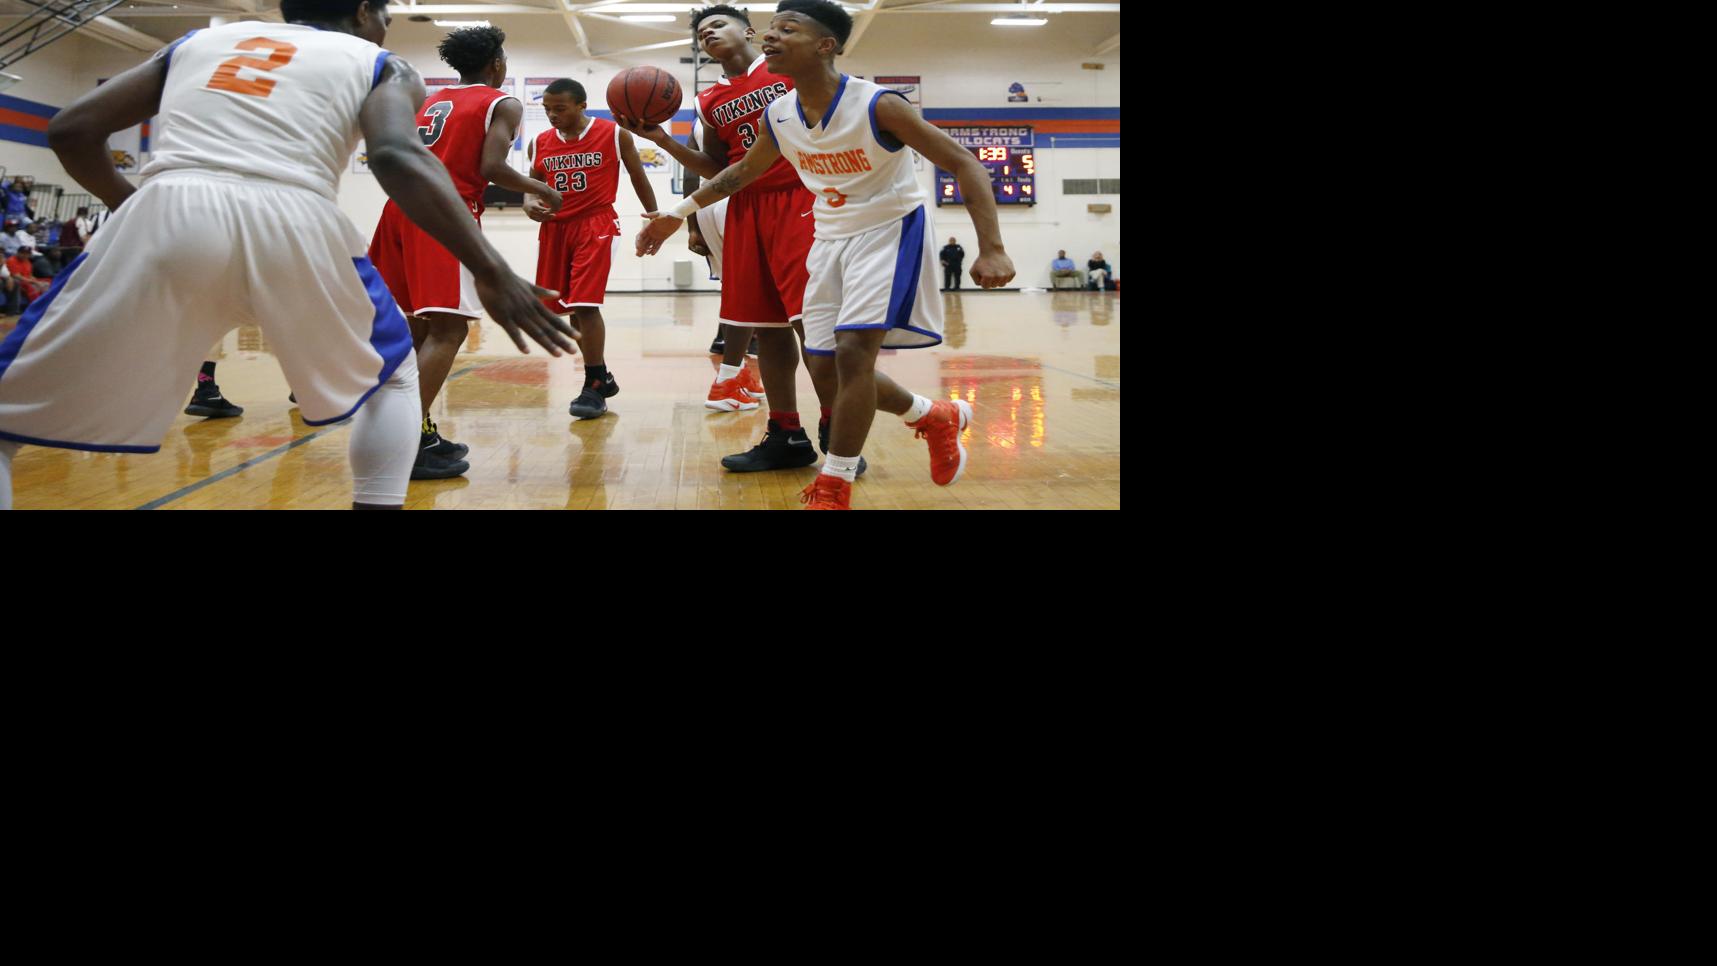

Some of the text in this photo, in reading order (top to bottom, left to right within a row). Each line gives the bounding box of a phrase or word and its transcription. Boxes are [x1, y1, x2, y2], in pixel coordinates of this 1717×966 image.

[206, 37, 298, 98] 2
[712, 82, 788, 127] VIKINGS
[417, 101, 454, 147] 3
[738, 118, 761, 150] 3
[543, 152, 602, 173] VIKINGS
[795, 149, 872, 175] RMSTRONG
[554, 171, 587, 192] 23
